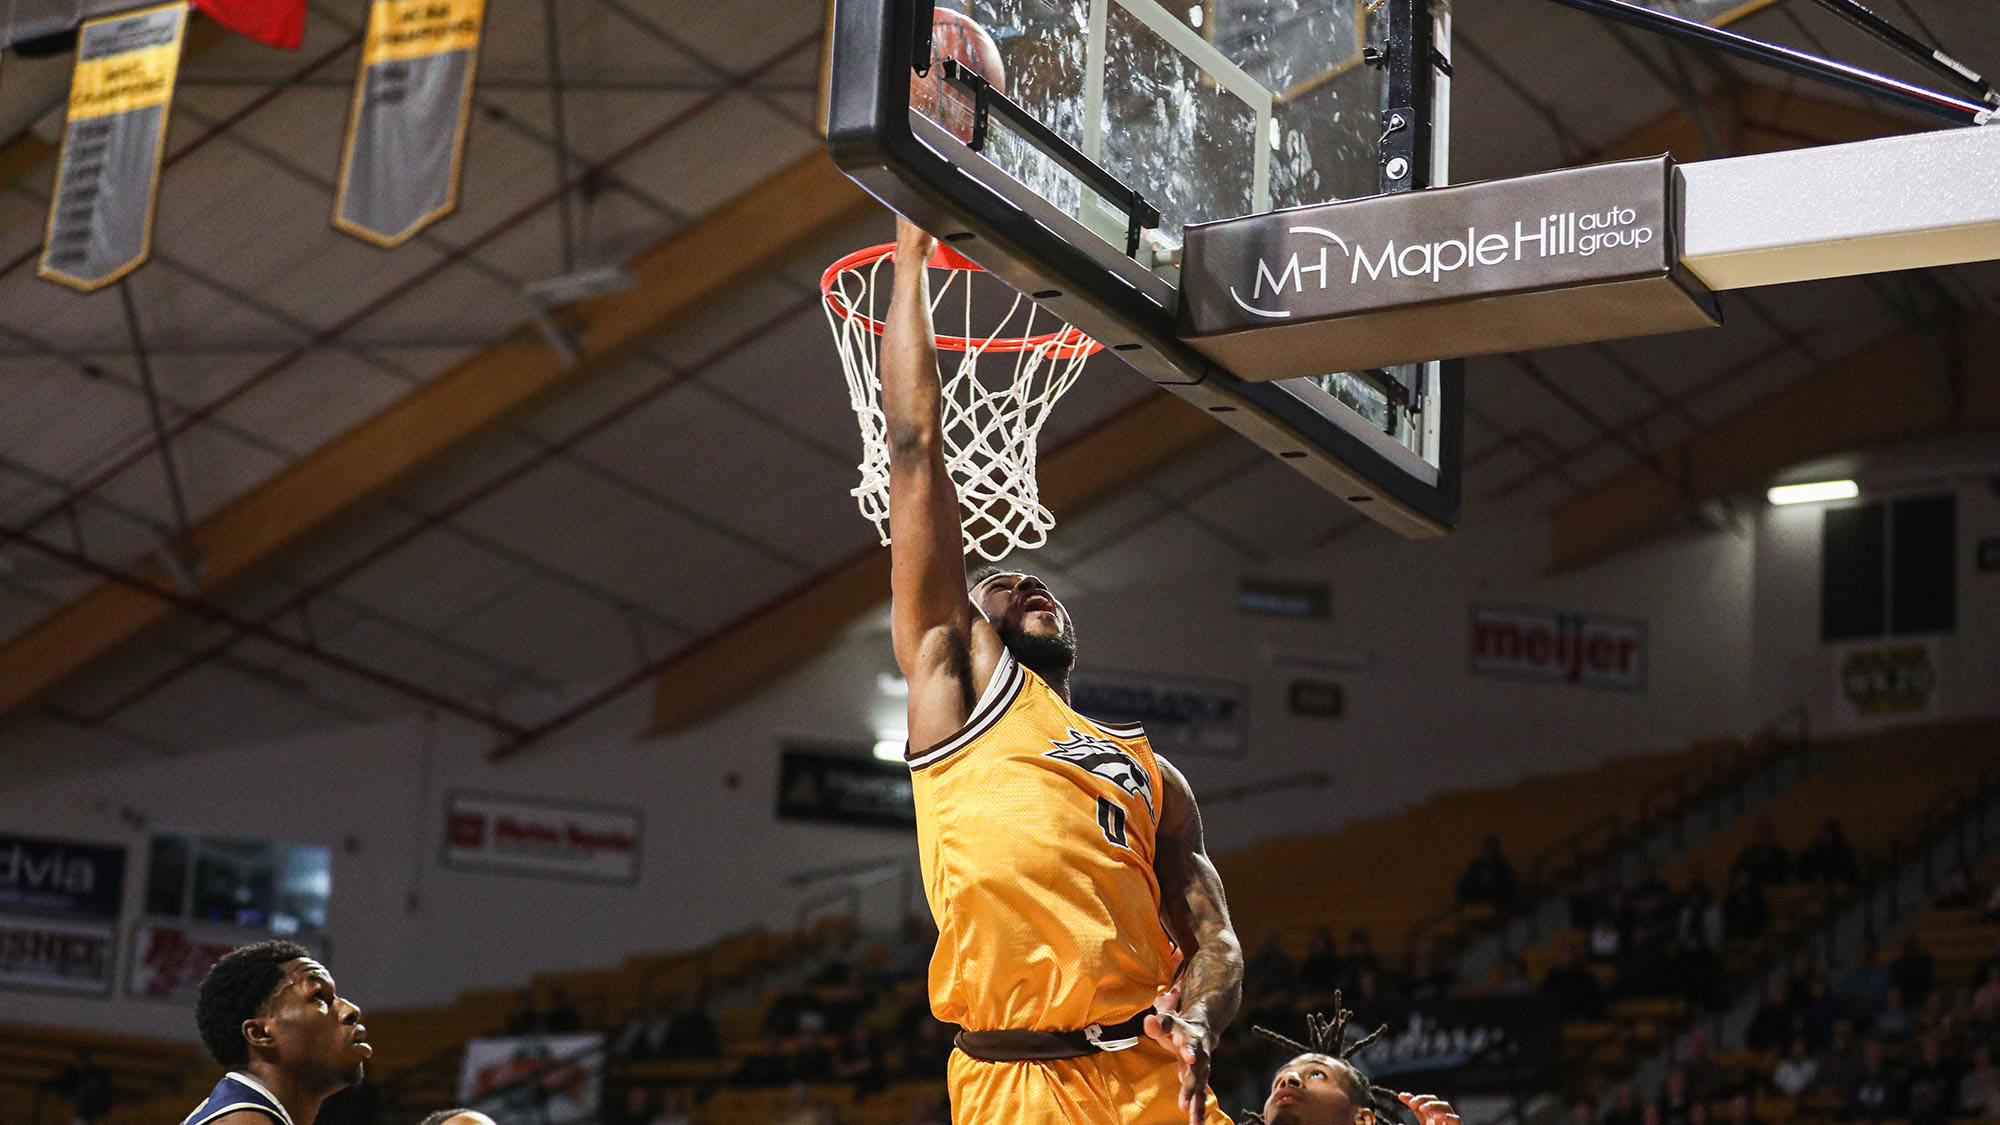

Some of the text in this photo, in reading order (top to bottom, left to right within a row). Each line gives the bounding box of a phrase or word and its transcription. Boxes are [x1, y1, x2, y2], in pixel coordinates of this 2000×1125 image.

[1578, 206, 1636, 230] auto
[1578, 225, 1653, 257] group
[1475, 615, 1638, 682] meijer
[1096, 795, 1130, 851] 0
